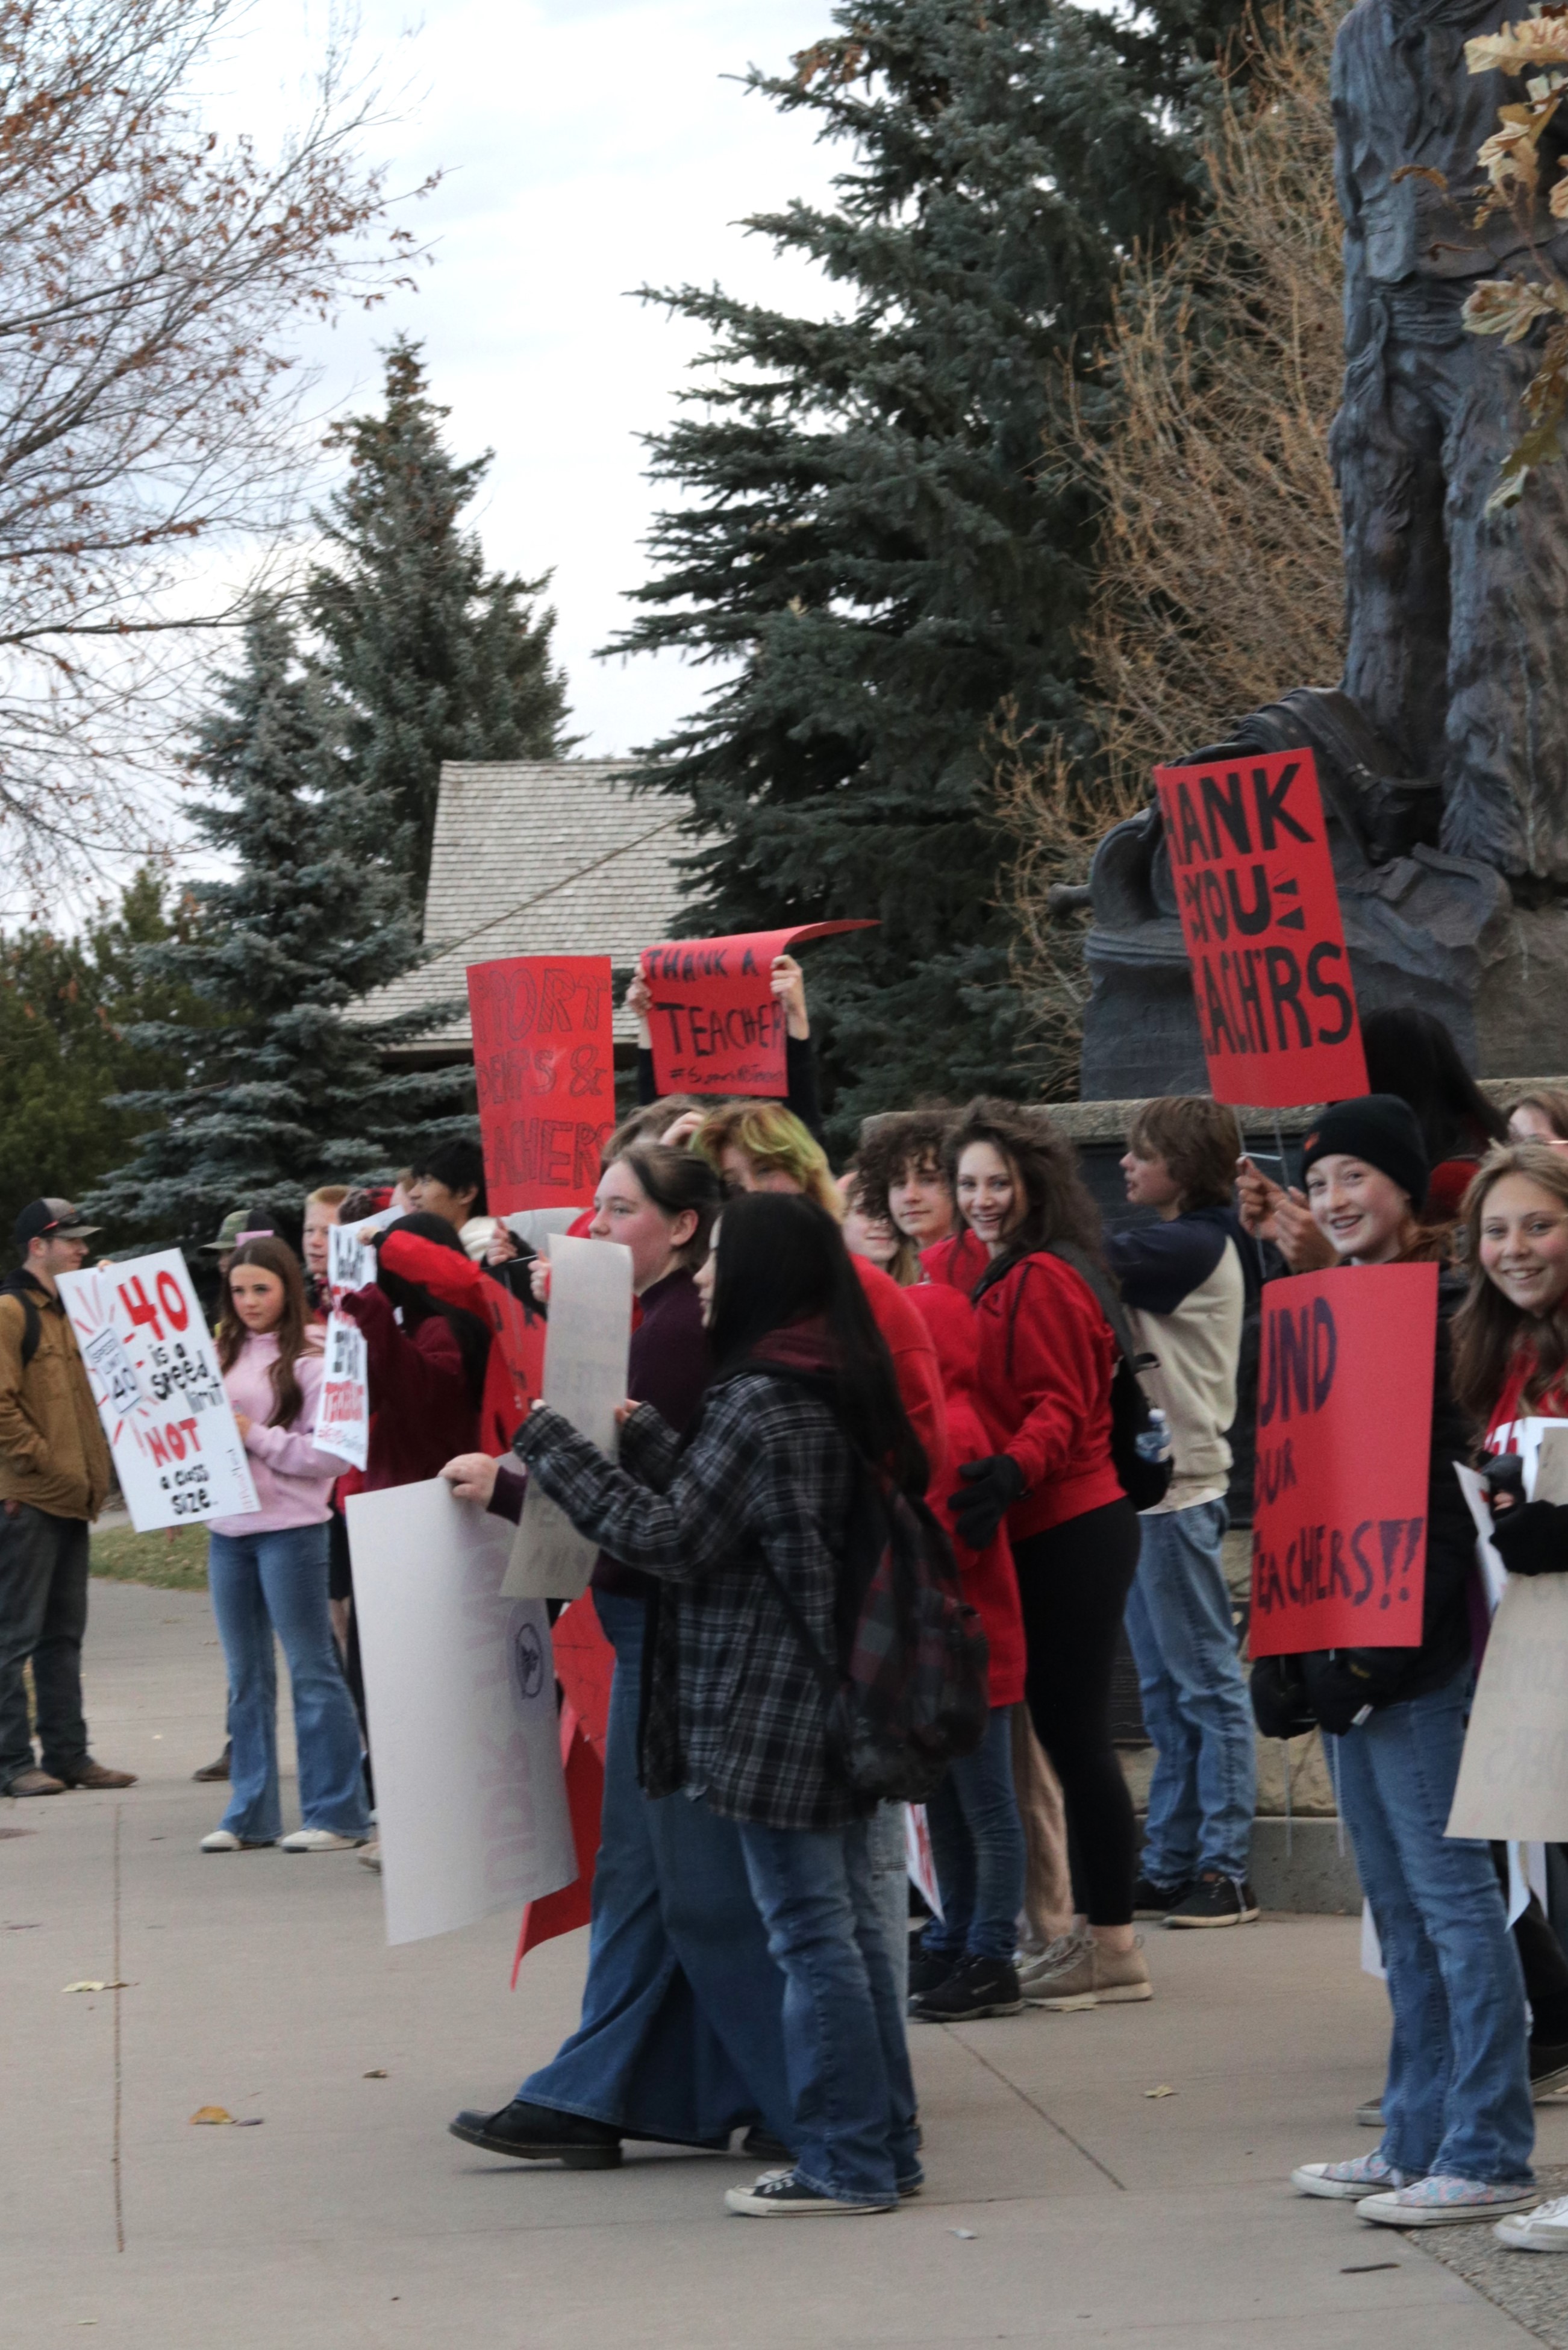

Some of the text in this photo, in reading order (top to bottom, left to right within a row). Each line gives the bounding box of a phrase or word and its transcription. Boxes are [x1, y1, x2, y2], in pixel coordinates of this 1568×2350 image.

[1182, 864, 1272, 944] YOU
[646, 947, 760, 983] THANK A
[569, 1044, 608, 1097] &
[117, 1270, 189, 1341] 40
[148, 1343, 186, 1367] is a
[113, 1367, 137, 1399] 40
[144, 1417, 202, 1468] NOT
[160, 1476, 170, 1490] a
